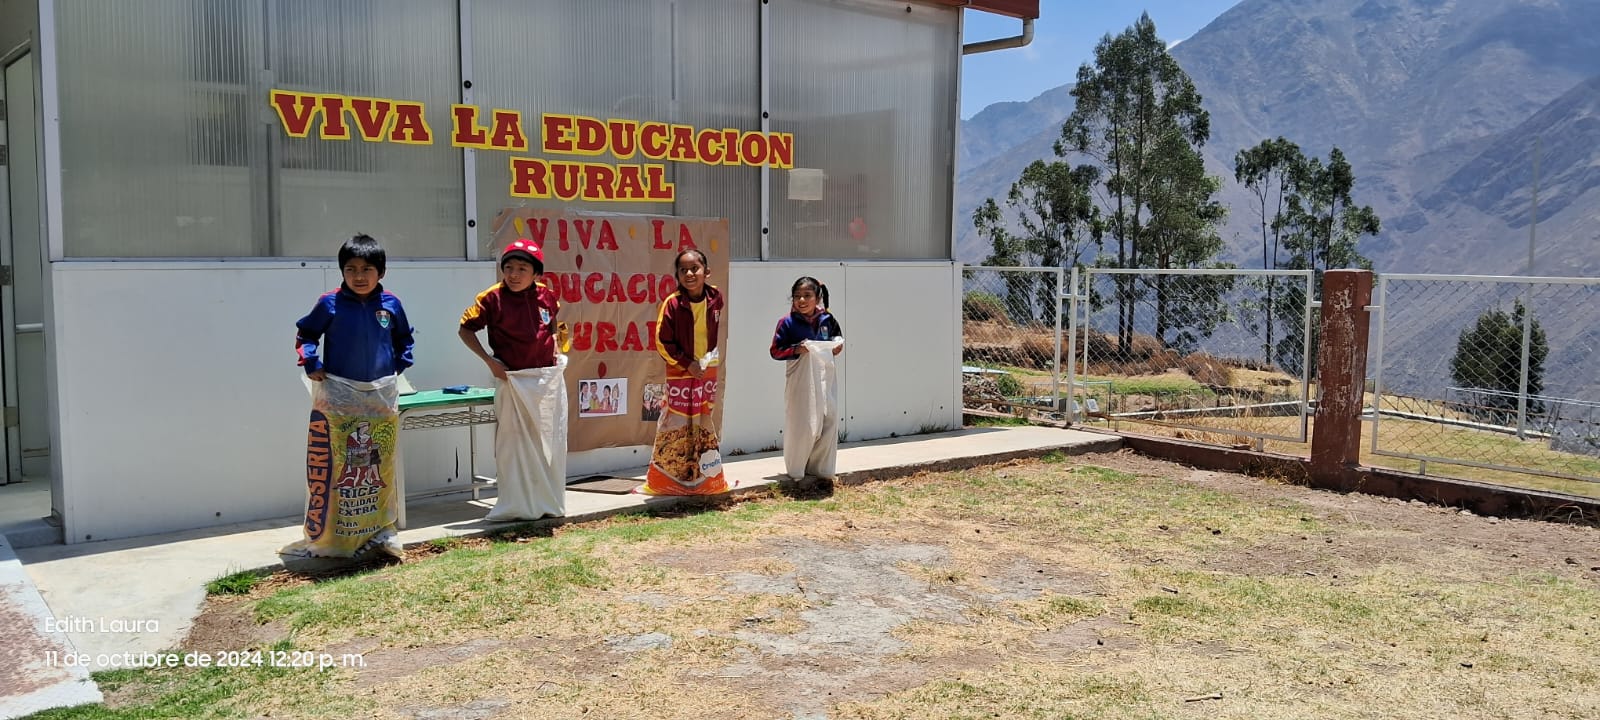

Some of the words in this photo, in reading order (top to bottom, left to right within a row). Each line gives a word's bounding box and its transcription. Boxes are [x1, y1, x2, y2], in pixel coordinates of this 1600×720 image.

[271, 89, 433, 144] VIVA
[451, 103, 528, 152] LA
[541, 112, 793, 169] EDUCACION
[509, 156, 674, 202] RURAL
[526, 218, 619, 251] VIVA
[651, 219, 698, 251] LA
[541, 272, 678, 304] DUCACIO
[306, 420, 329, 537] CASSERITA
[339, 486, 380, 499] RICE
[338, 496, 379, 508] CALIDAD
[338, 505, 378, 517] EXTRA
